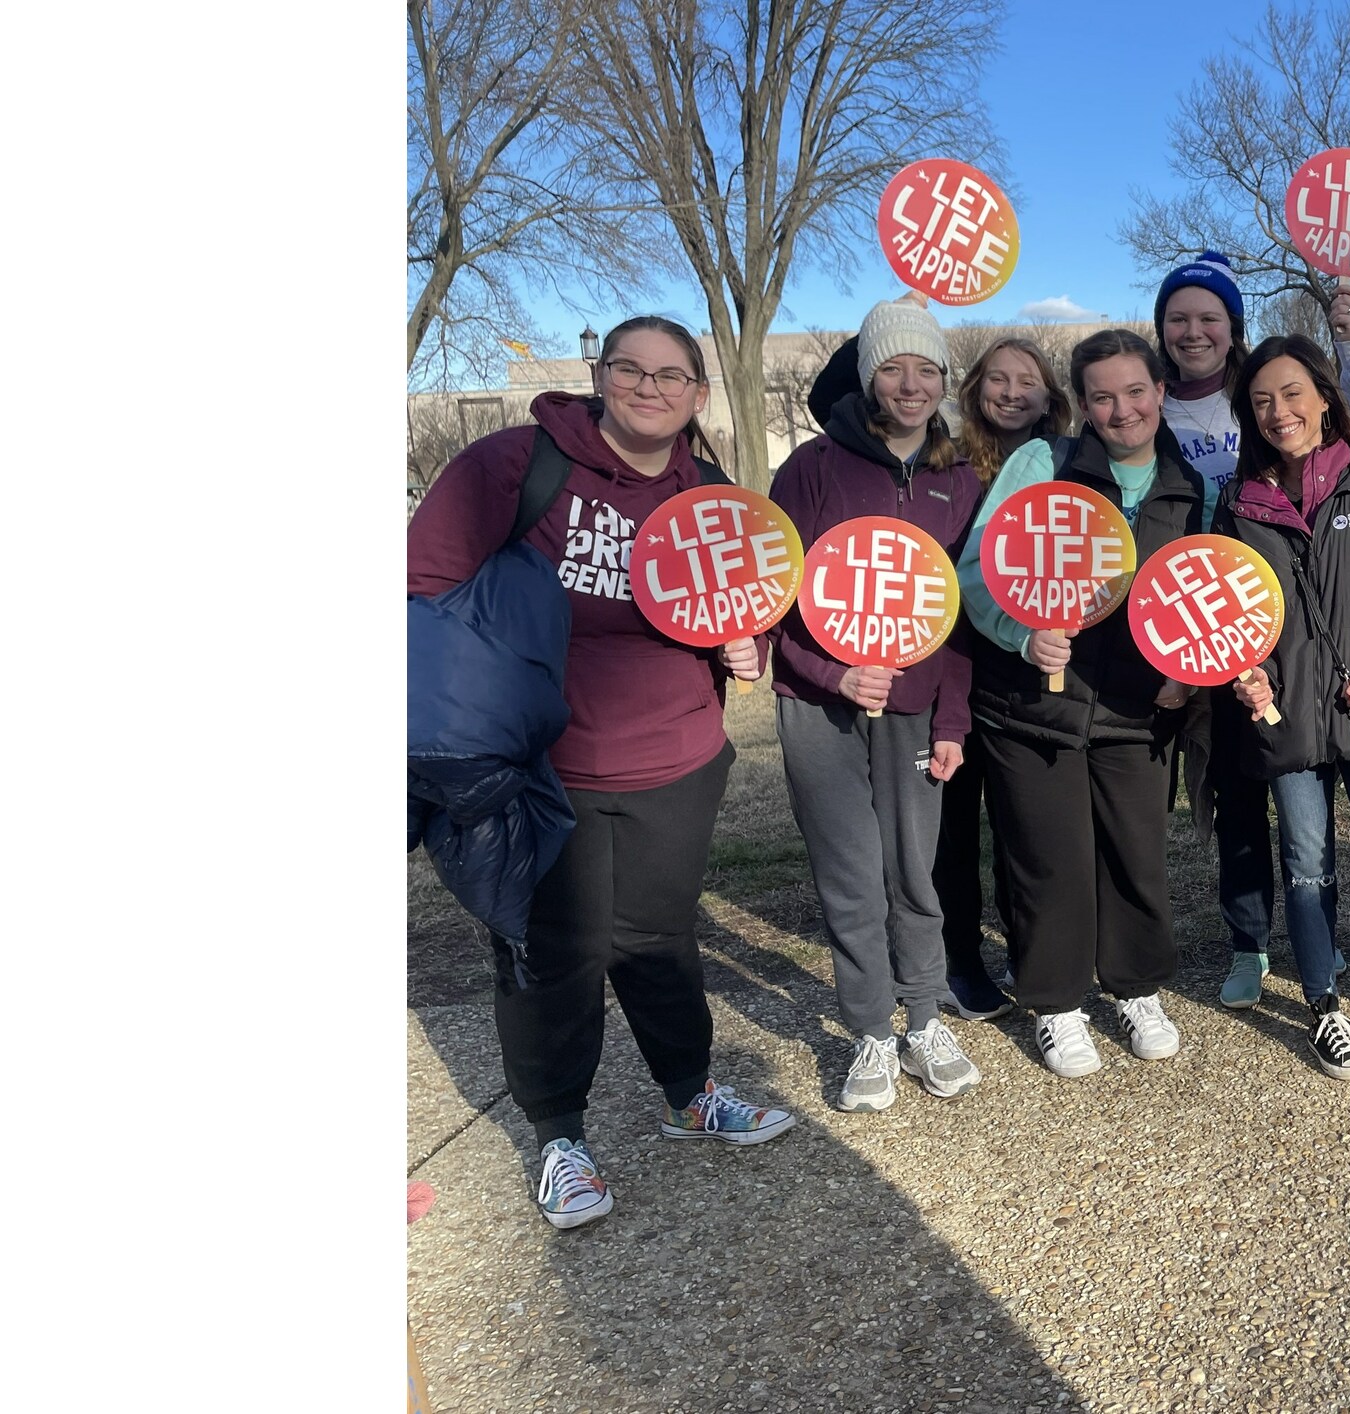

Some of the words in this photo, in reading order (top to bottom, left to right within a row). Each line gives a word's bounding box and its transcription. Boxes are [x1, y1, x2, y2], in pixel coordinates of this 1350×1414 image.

[931, 172, 999, 226] LET
[892, 184, 1009, 278] LIFE
[892, 229, 981, 295] HAPPEN
[1223, 432, 1240, 452] M
[569, 495, 583, 527] I
[669, 499, 748, 551] LET
[1025, 494, 1095, 534] LET
[645, 530, 791, 603] LIFE
[847, 529, 920, 572] LET
[995, 534, 1123, 578] LIFE
[557, 559, 633, 601] GENE
[754, 567, 799, 631] SAVETHESTORKS.ORG
[813, 566, 946, 617] LIFE
[1007, 579, 1112, 620] HAPPEN
[1077, 575, 1129, 625] SAVETHESTORKS.ORG
[1150, 548, 1218, 606] LET
[671, 578, 785, 634] HAPPEN
[1144, 563, 1270, 656] LIFE
[1254, 591, 1278, 659] SAVETHESTORKS.ORG
[823, 612, 933, 658] HAPPEN
[895, 616, 951, 664] SAVETHESTORKS.ORG
[1180, 608, 1273, 673] HAPPEN
